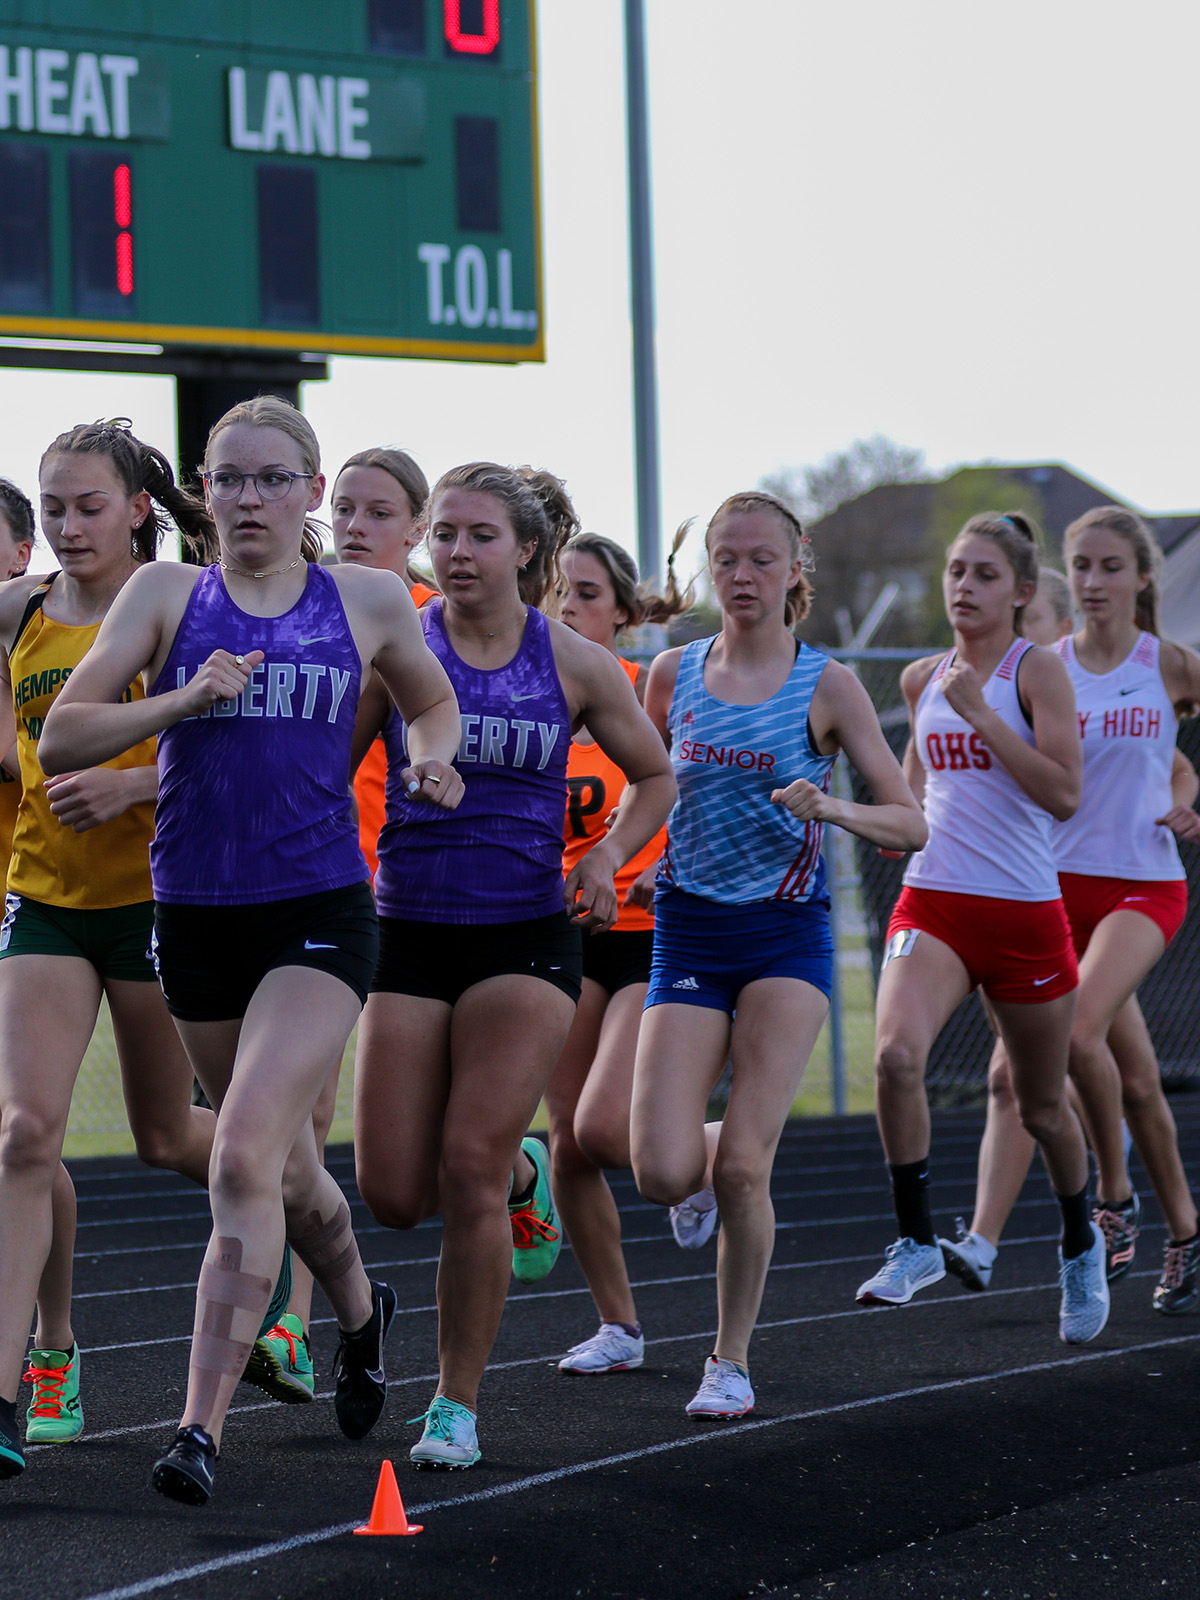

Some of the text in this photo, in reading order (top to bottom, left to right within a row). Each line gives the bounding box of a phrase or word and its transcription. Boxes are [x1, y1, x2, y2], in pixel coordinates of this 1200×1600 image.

[228, 67, 372, 159] LANE
[113, 164, 134, 296] 1
[418, 243, 537, 330] T.O.L.
[926, 731, 993, 771] OHS
[1102, 706, 1161, 740] HIGH
[679, 739, 777, 775] SENIOR
